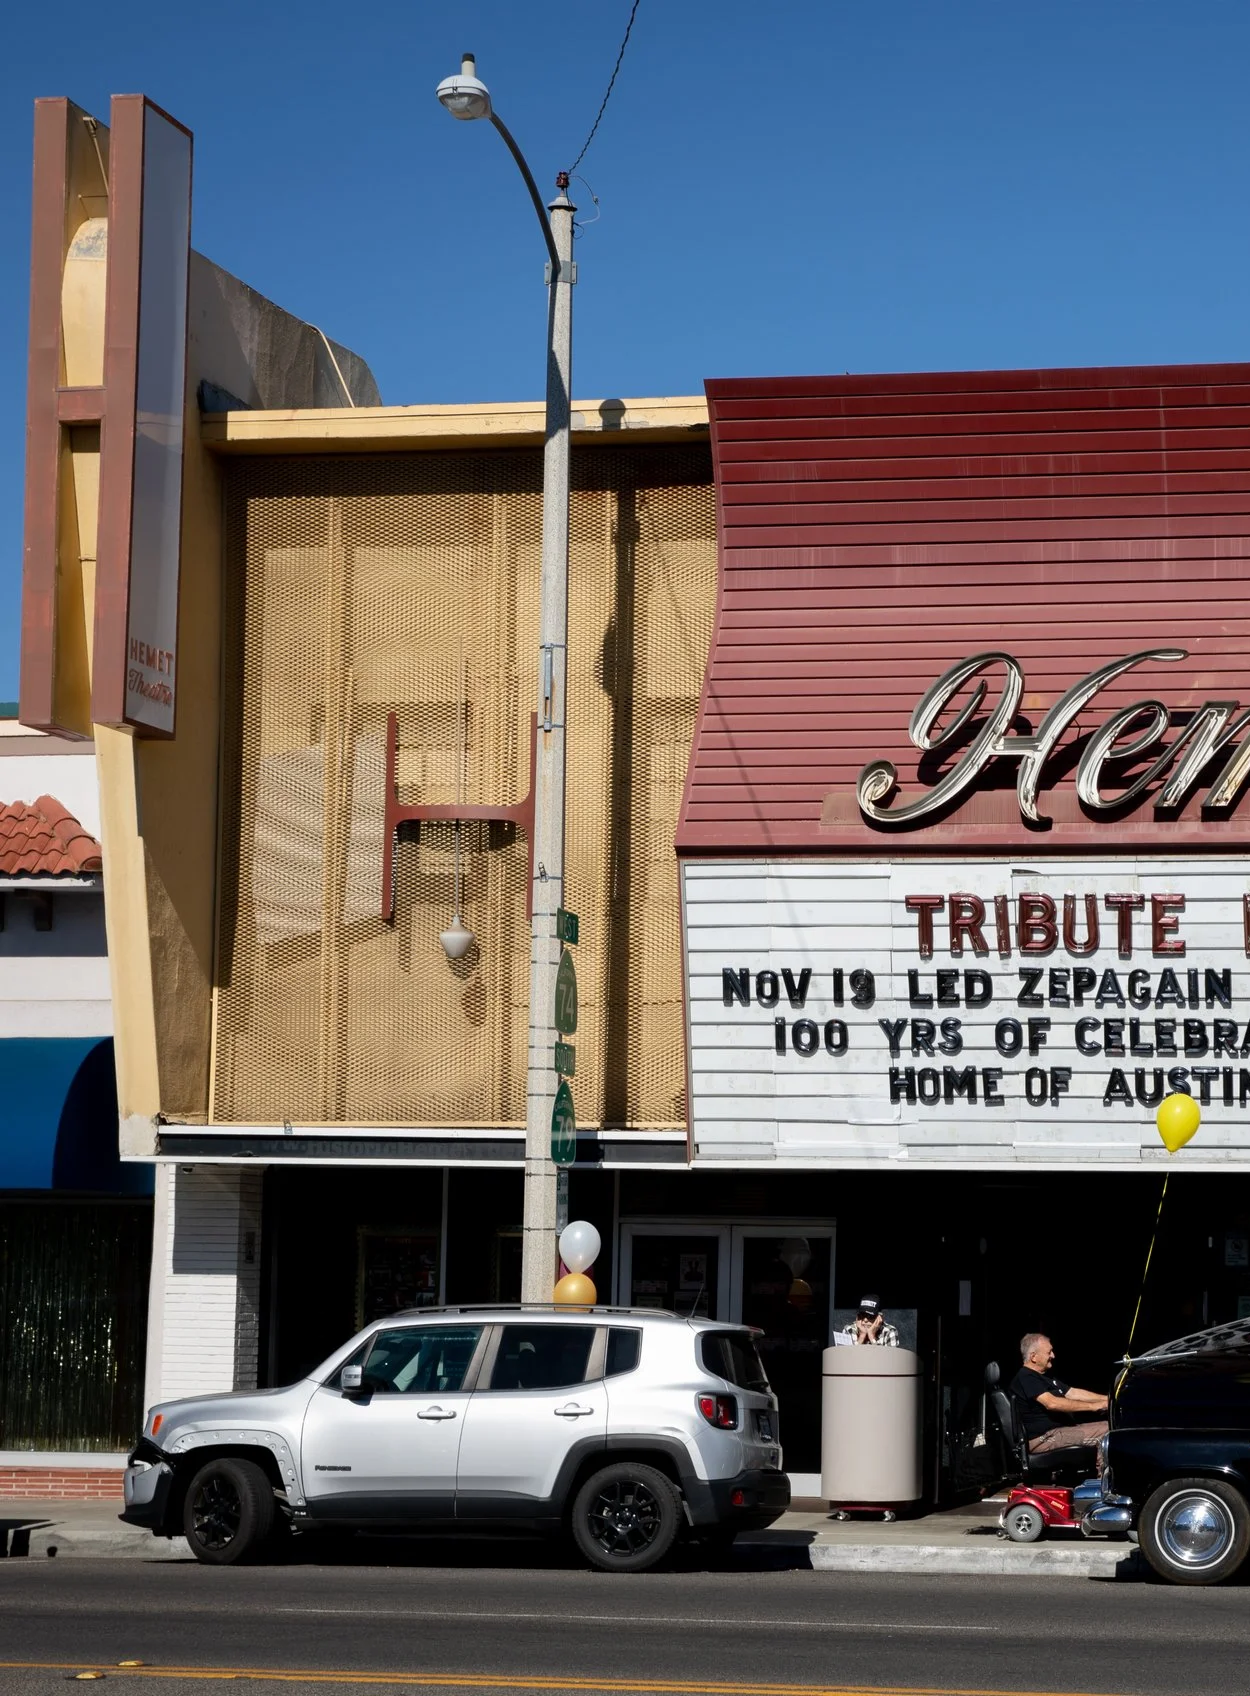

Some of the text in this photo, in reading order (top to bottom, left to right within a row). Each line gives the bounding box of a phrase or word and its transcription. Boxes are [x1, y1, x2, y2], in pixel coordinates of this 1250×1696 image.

[129, 637, 174, 676] HEMET
[904, 892, 1187, 959] TRIBUTE
[559, 984, 575, 1022] 74
[721, 967, 812, 1009] NOV
[832, 967, 877, 1009] 19
[907, 967, 993, 1008] LED
[1017, 967, 1232, 1009] ZEPAGAIN
[774, 1017, 849, 1058] 100
[877, 1017, 964, 1058] YRS
[994, 1017, 1051, 1058] OF
[889, 1066, 1004, 1106] HOME
[1024, 1066, 1073, 1106] OF
[556, 1115, 574, 1153] 79
